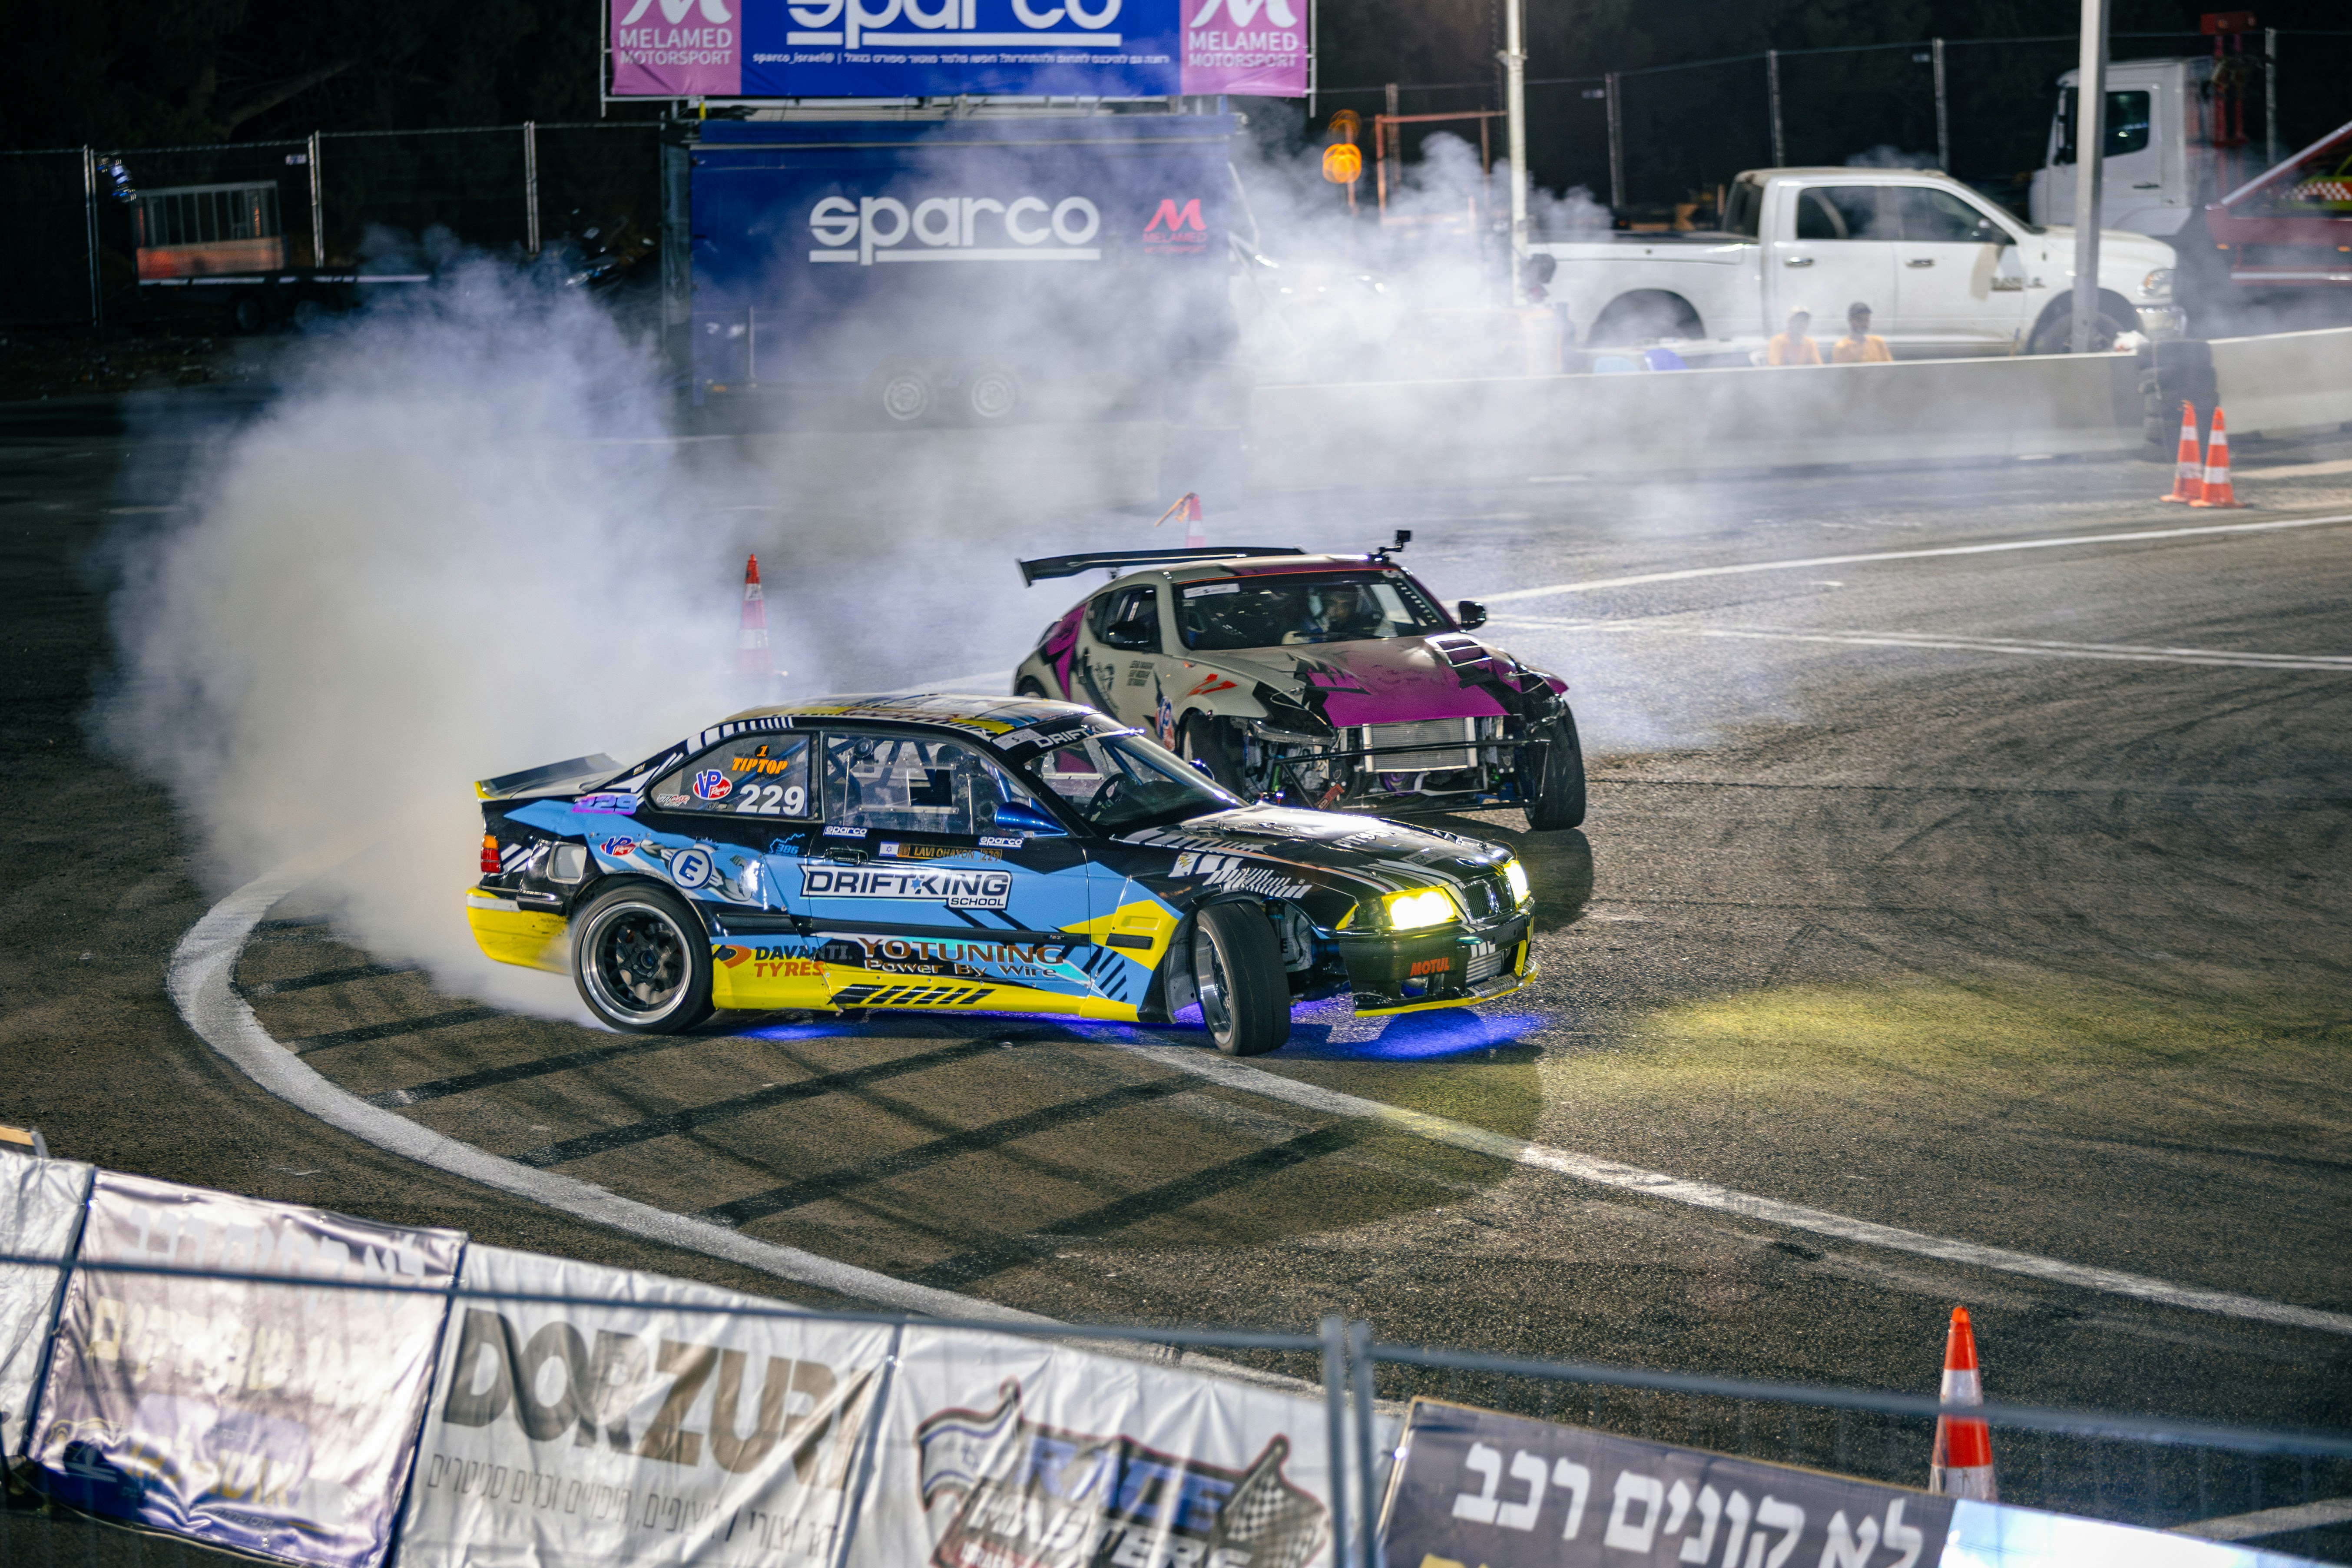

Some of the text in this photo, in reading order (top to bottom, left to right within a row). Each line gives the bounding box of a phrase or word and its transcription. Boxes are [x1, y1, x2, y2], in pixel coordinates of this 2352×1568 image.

[619, 28, 732, 49] MELAMED
[1189, 31, 1298, 51] MELAMED
[620, 50, 732, 65] MOTORSPORT
[1189, 53, 1298, 68] MOTORSPORT
[809, 196, 1101, 265] sparco
[696, 769, 722, 799] VP
[736, 784, 805, 816] 229
[824, 826, 868, 837] sparco
[980, 836, 1023, 847] sparco
[776, 843, 799, 855] 386
[914, 847, 1000, 861] LAVI OHAYON 229
[950, 897, 1004, 906] SCHOOL
[858, 937, 1063, 964] YOTUNING
[754, 961, 824, 978] TYRES
[865, 958, 1057, 978] Power By Wire
[1410, 957, 1450, 977] MOTUL
[1451, 1442, 1923, 1568] לא קונים רכב
